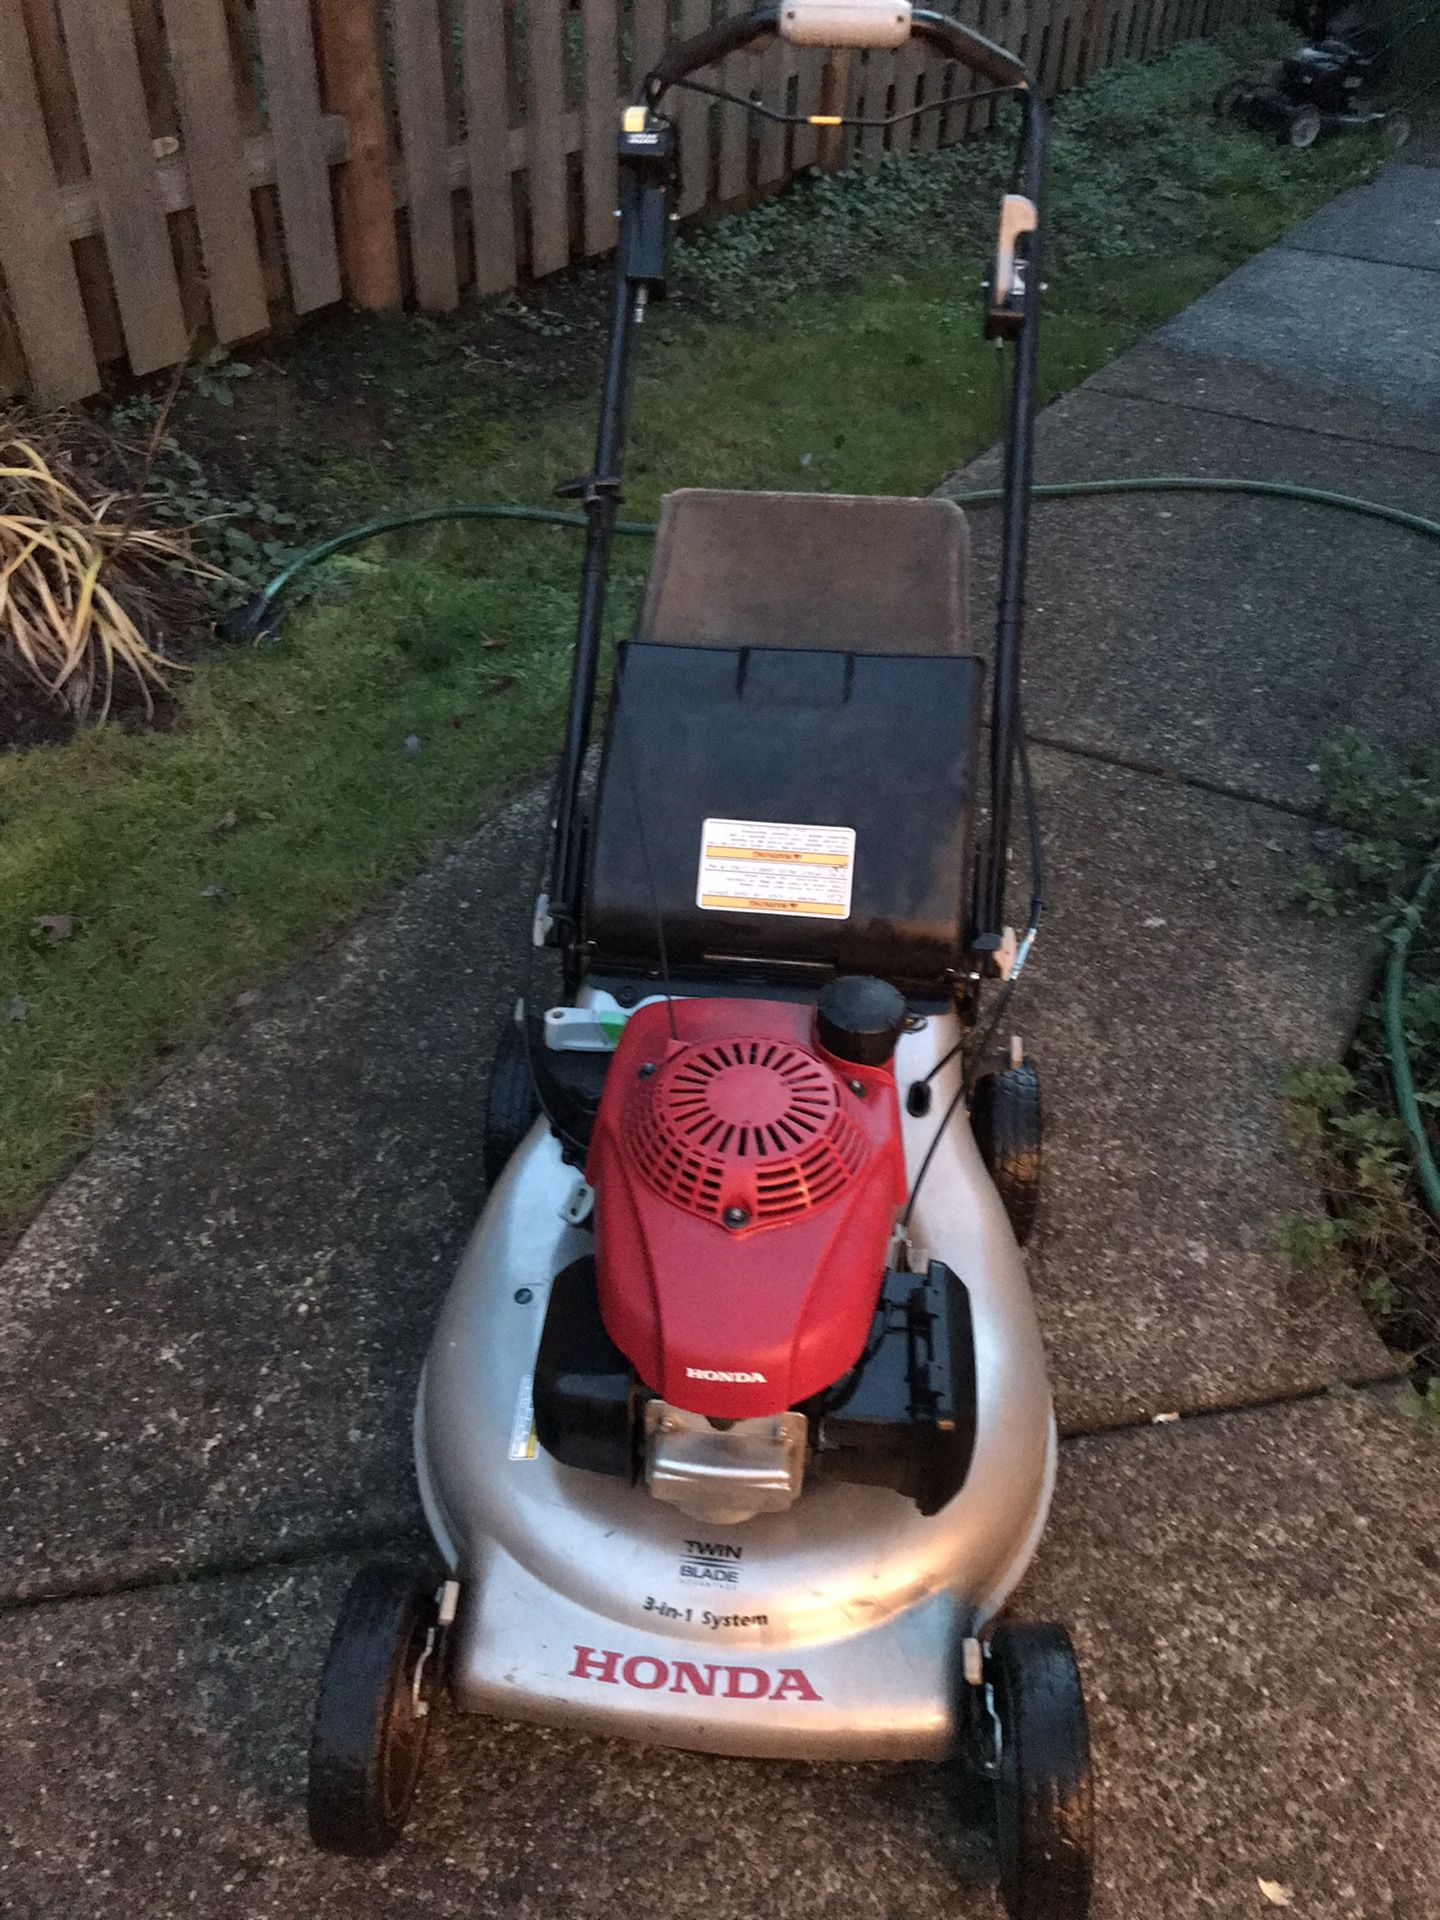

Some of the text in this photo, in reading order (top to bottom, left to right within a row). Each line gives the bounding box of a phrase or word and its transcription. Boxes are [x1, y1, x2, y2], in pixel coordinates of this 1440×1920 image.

[685, 1367, 767, 1383] HONDA
[684, 1540, 743, 1559] TWIN
[680, 1565, 740, 1583] BLADE
[643, 1596, 769, 1629] 3-in-1 System
[568, 1645, 824, 1701] HONDA
